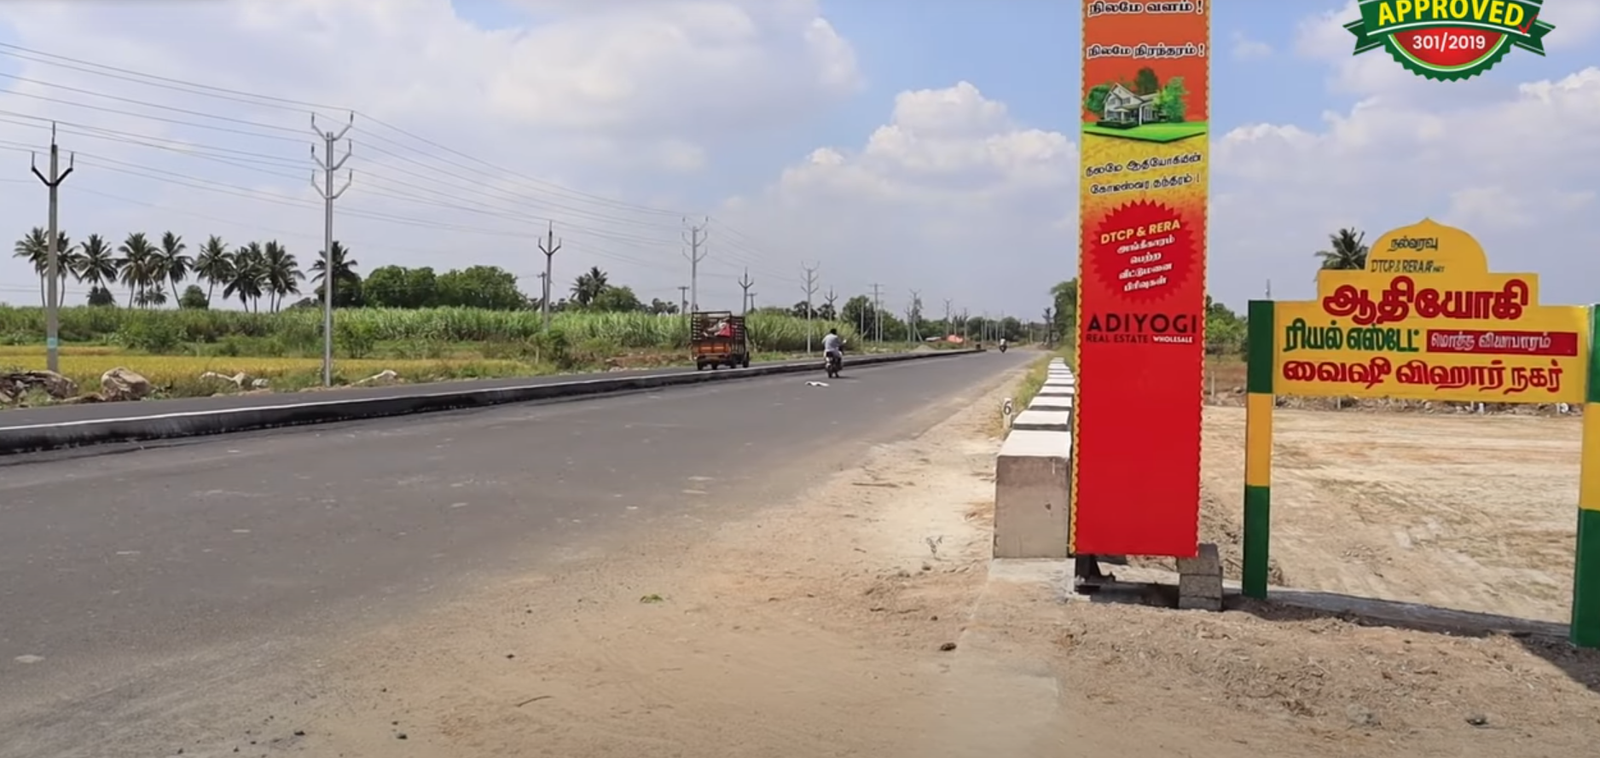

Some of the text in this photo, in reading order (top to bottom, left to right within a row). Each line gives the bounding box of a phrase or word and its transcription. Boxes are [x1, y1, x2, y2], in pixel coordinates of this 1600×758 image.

[1089, 1, 1142, 15] நிலமே
[1147, 0, 1193, 12] வளம்
[1088, 44, 1131, 57] நிலமே
[1134, 43, 1196, 57] நிரந்தரம்
[1101, 219, 1181, 244] DTCP & RERA
[1387, 235, 1438, 252] நல்வரவு
[1323, 276, 1529, 325] ஆதியோகி
[1087, 313, 1197, 334] ADIYOGI
[1086, 334, 1193, 343] REAL ESTATE WHOLESALE
[1283, 318, 1551, 352] ரியல் எஸ்டேட் மொத்த வியாபாரம்
[1396, 359, 1506, 392] விஹார்
[1503, 358, 1563, 395] நகர்
[1004, 401, 1012, 415] 6
